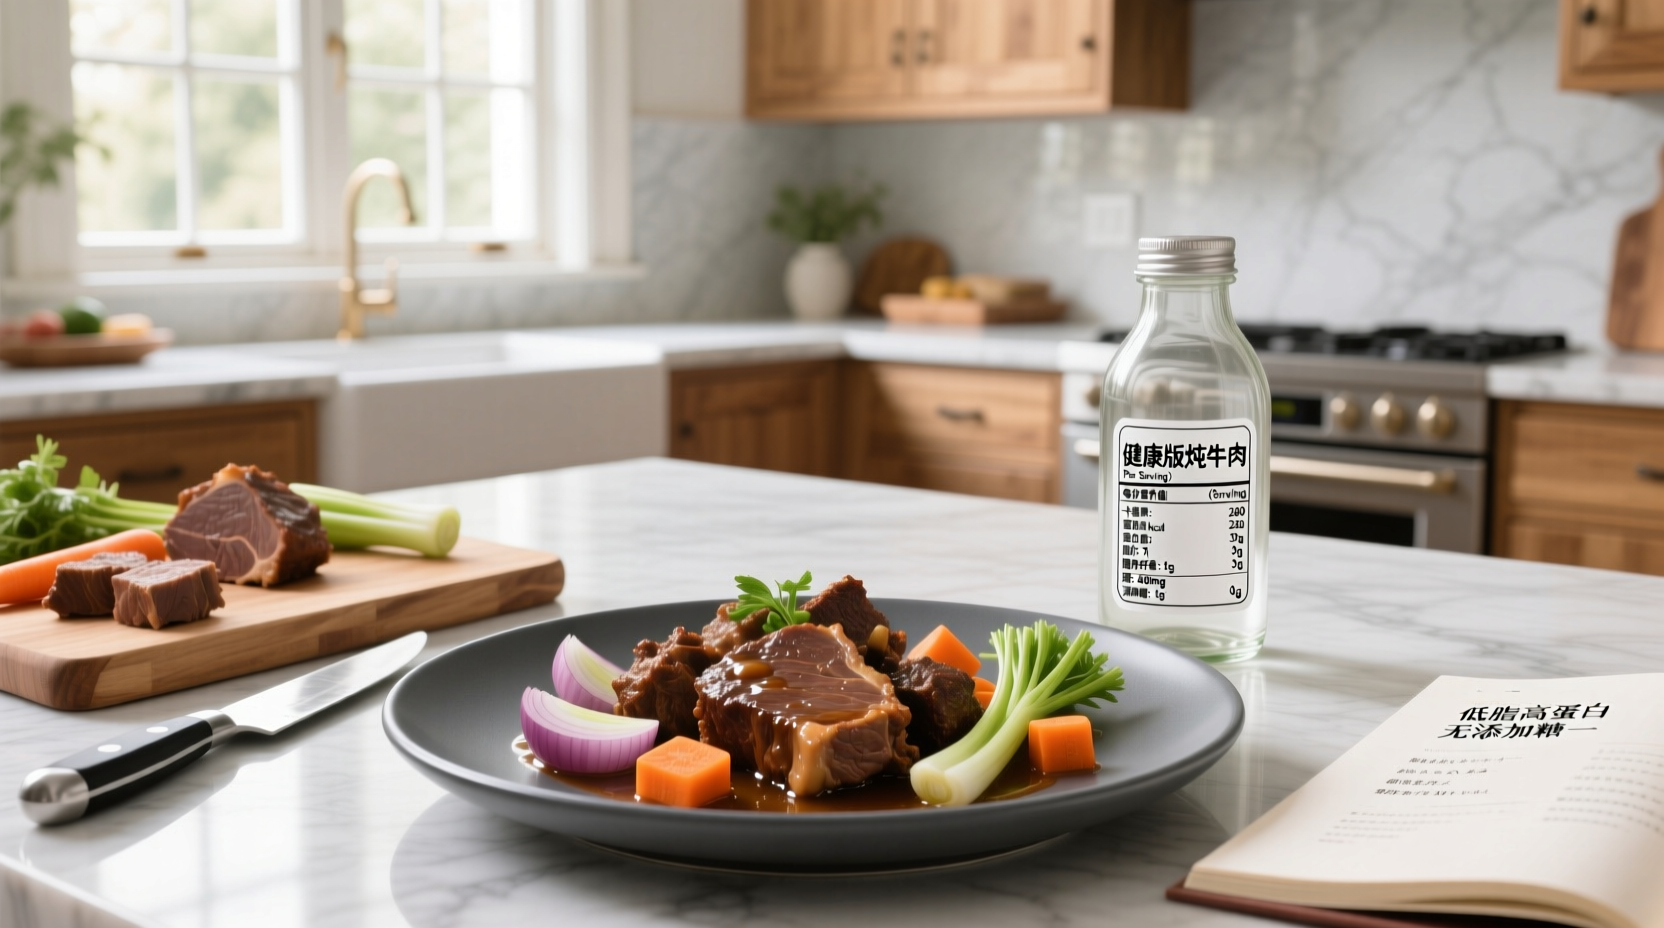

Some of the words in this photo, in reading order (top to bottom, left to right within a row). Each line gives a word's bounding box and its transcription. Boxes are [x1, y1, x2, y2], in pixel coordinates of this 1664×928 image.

[1123, 442, 1247, 468] 健康版炖牛肉
[1459, 702, 1610, 721] 低脂高蛋白
